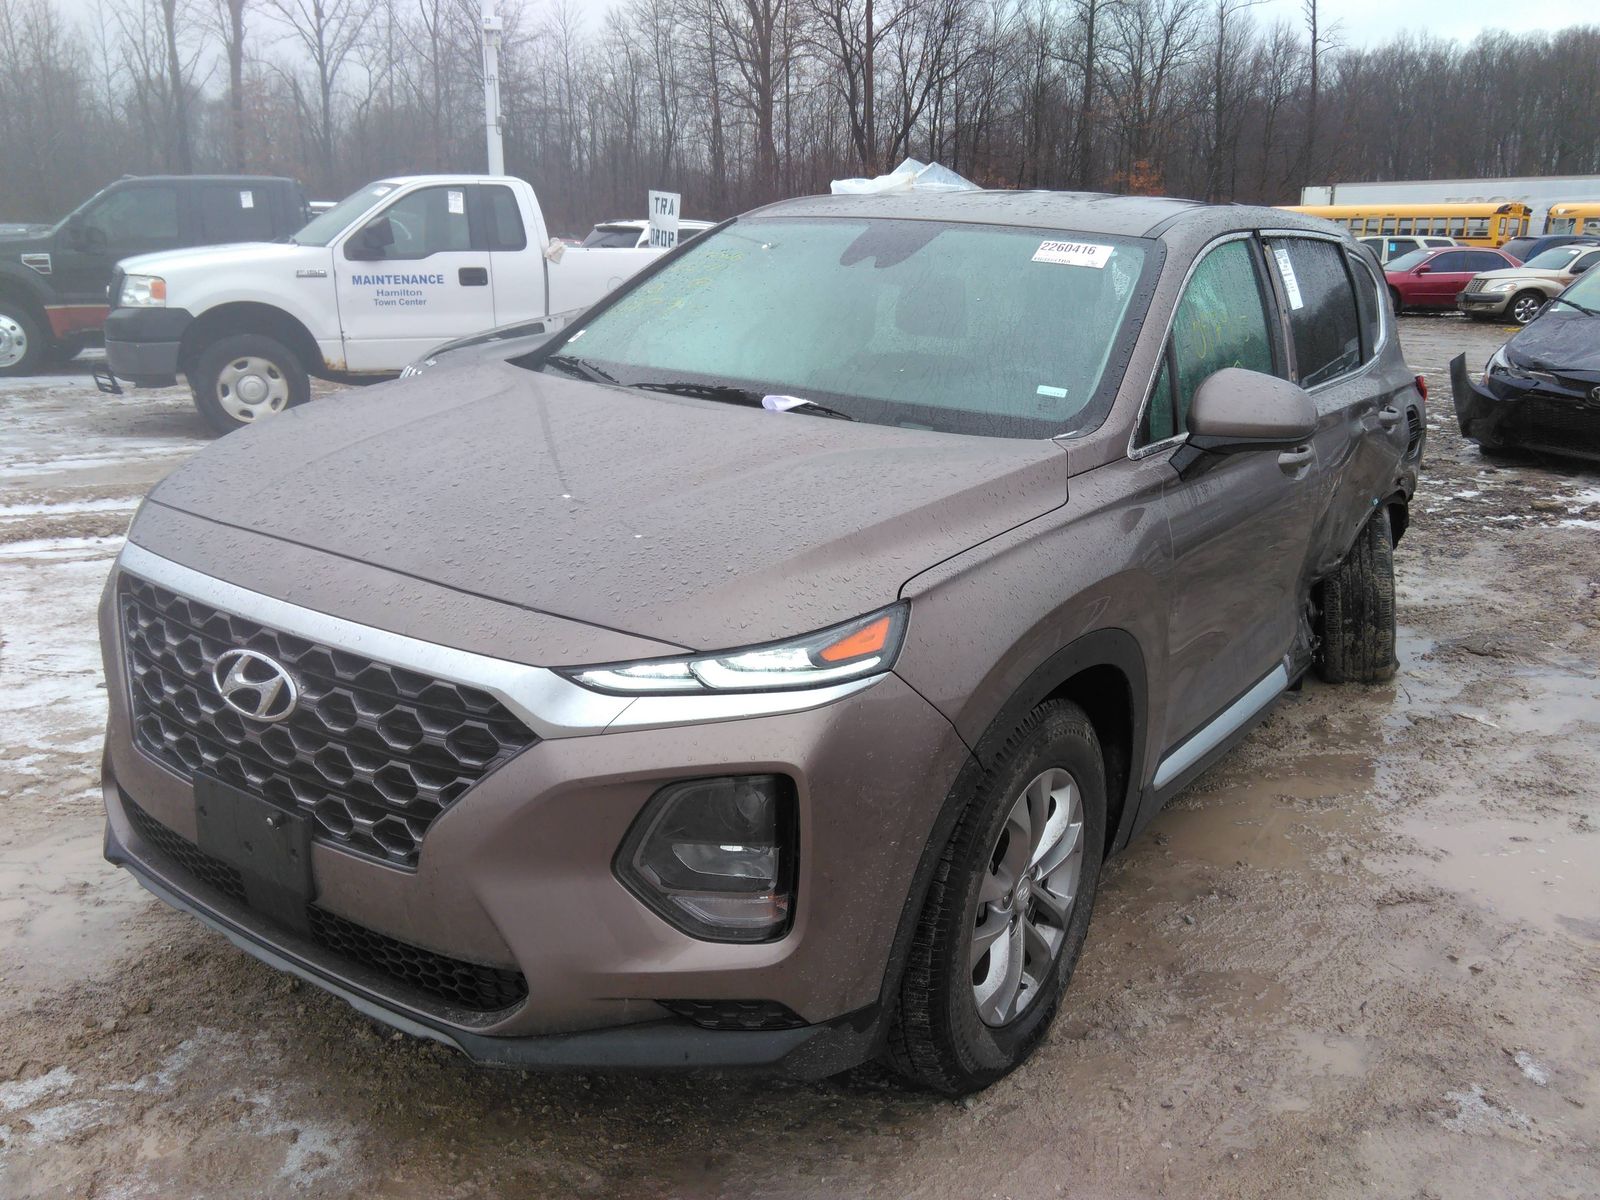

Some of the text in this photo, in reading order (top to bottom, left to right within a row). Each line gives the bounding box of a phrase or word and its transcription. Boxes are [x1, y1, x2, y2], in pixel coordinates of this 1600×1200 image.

[654, 196, 674, 216] TRA
[650, 228, 675, 248] DROP
[1040, 241, 1097, 255] 2260416
[351, 274, 445, 286] MAINTENANCE
[376, 289, 423, 297] Hamilton
[373, 298, 427, 307] Town Center
